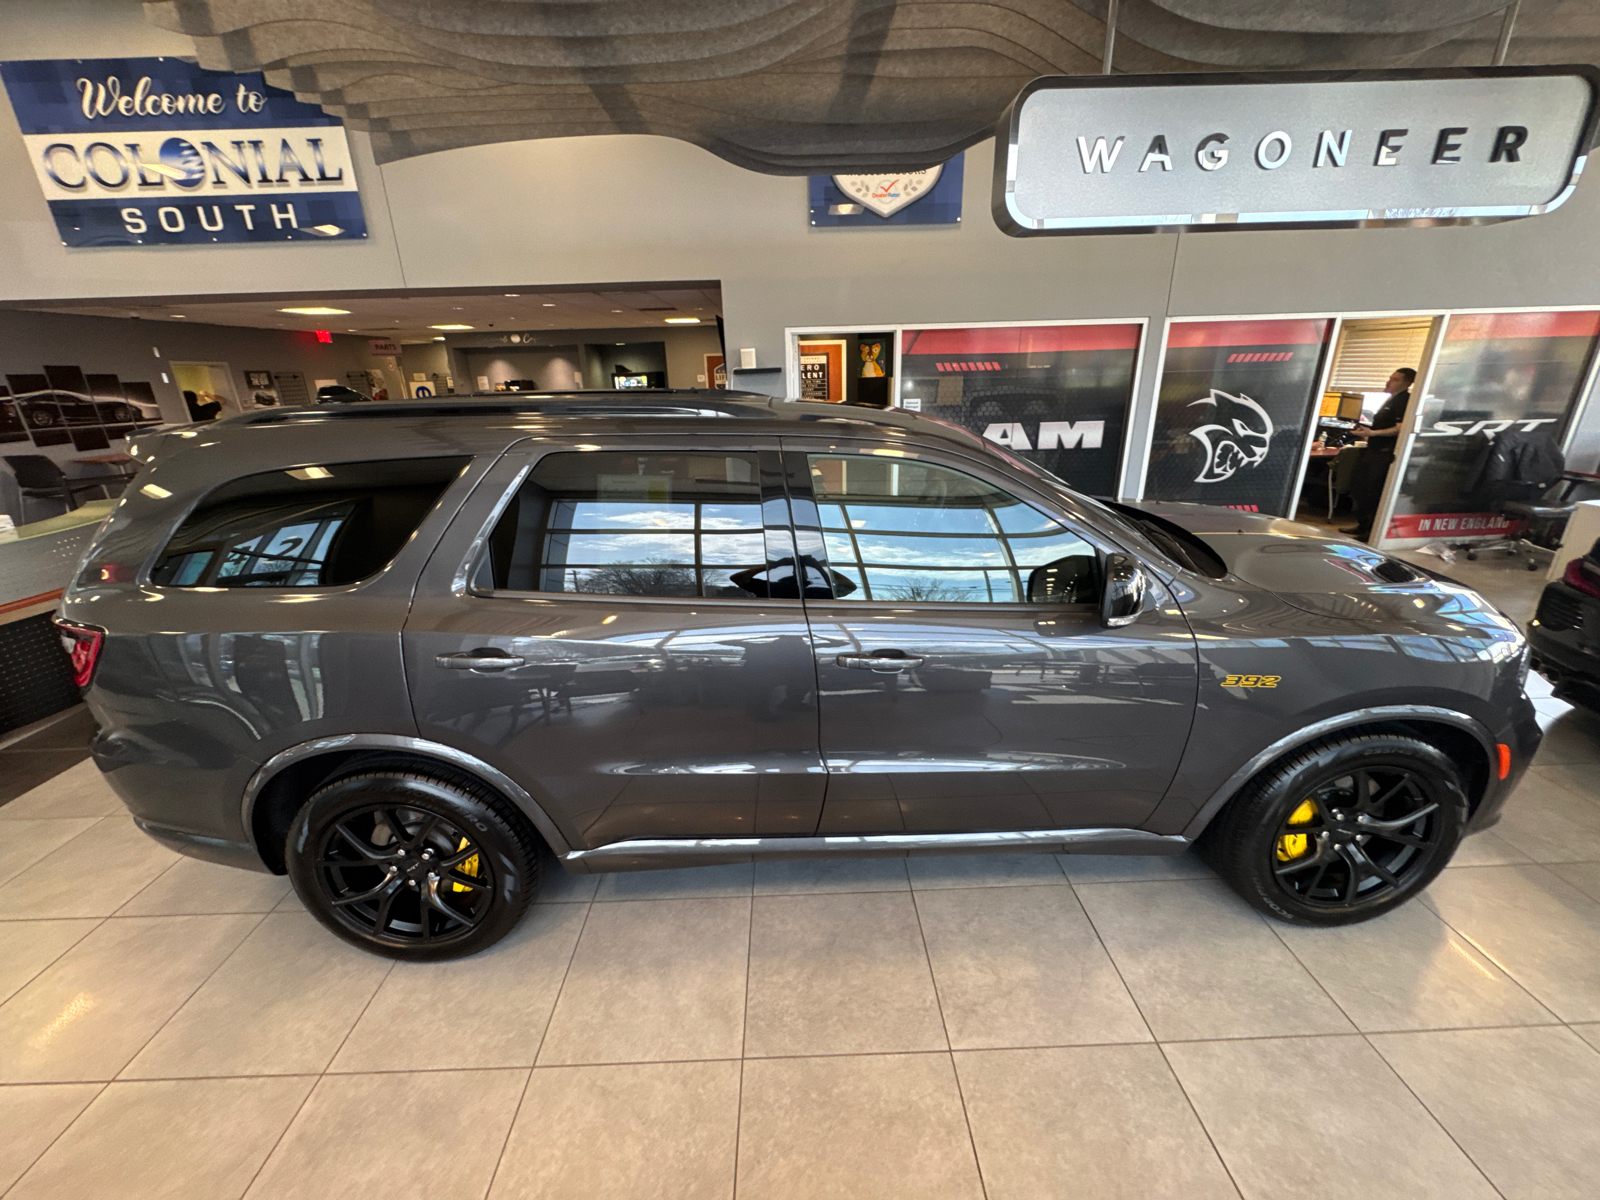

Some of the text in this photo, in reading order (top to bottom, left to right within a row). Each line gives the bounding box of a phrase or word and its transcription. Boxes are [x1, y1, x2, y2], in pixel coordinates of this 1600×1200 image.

[77, 76, 267, 119] Welcome to
[42, 137, 344, 190] COLONIAL
[1075, 125, 1529, 174] WAGONEER
[120, 203, 300, 234] SOUTH
[375, 343, 397, 351] PARTS
[802, 371, 823, 379] LENT
[982, 420, 1105, 451] AM
[1418, 418, 1558, 446] SRT
[1418, 518, 1431, 531] IN
[1433, 517, 1456, 531] NEW
[1220, 674, 1282, 688] 392
